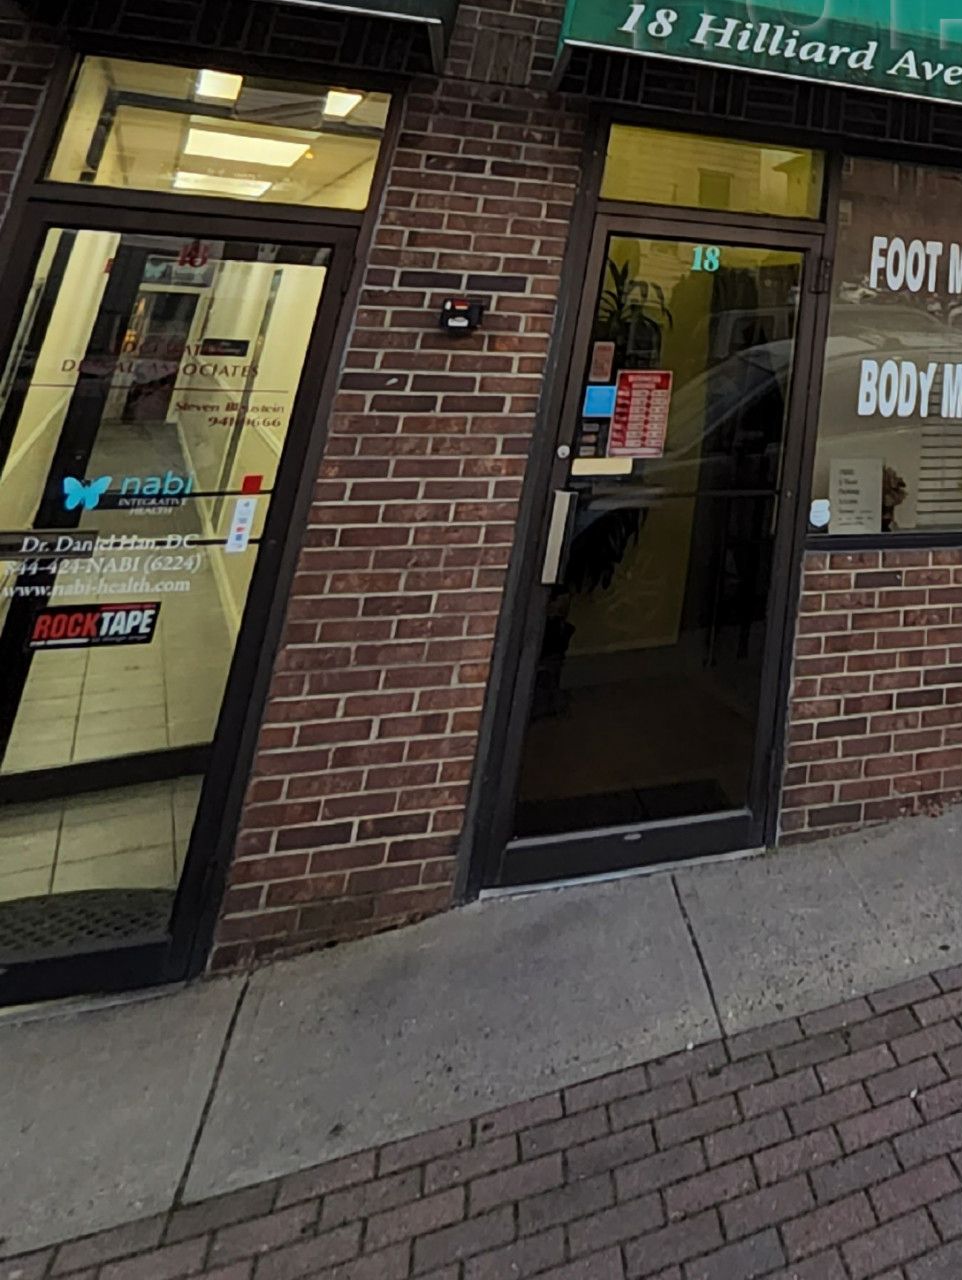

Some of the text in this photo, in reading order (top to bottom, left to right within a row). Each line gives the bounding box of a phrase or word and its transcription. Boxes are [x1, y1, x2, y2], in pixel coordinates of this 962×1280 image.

[617, 2, 678, 38] 18
[691, 13, 878, 71] Hilliard
[691, 245, 720, 272] 18
[869, 236, 943, 292] FOOT
[857, 359, 937, 418] BODY
[121, 469, 194, 495] nabi
[20, 536, 49, 553] Dr.
[166, 533, 200, 549] DC
[143, 554, 202, 576] (6224)
[32, 609, 155, 640] ROCKTAPE
